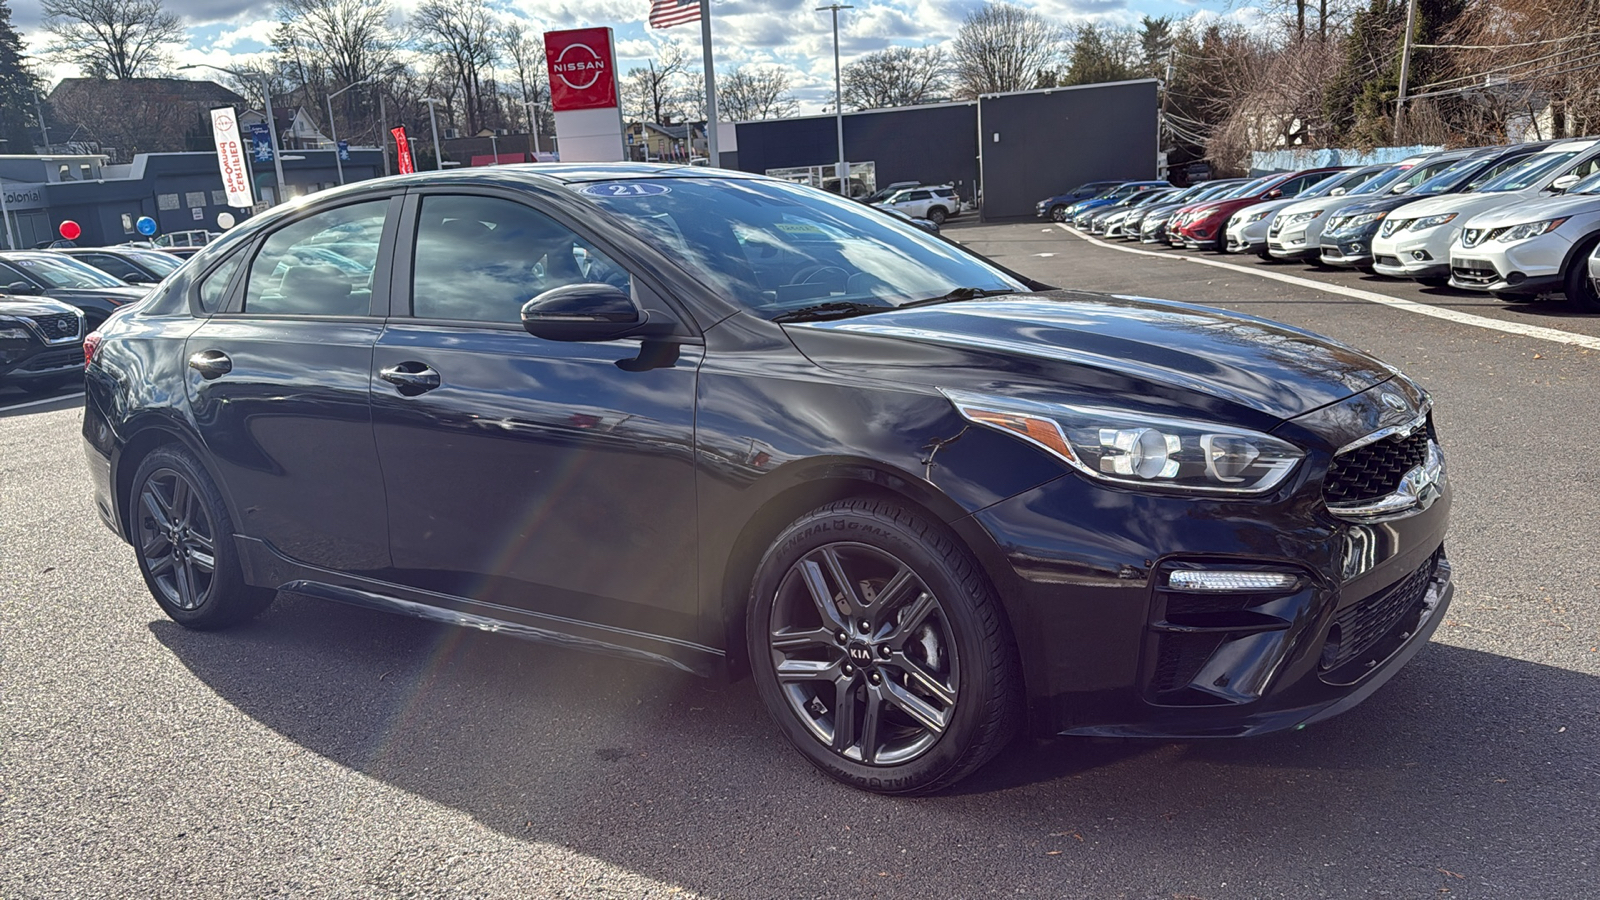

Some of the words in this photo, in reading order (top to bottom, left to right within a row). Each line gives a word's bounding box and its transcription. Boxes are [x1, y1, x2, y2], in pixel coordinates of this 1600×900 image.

[553, 60, 604, 72] NISSAN
[608, 184, 649, 196] 21
[850, 648, 870, 659] KIA
